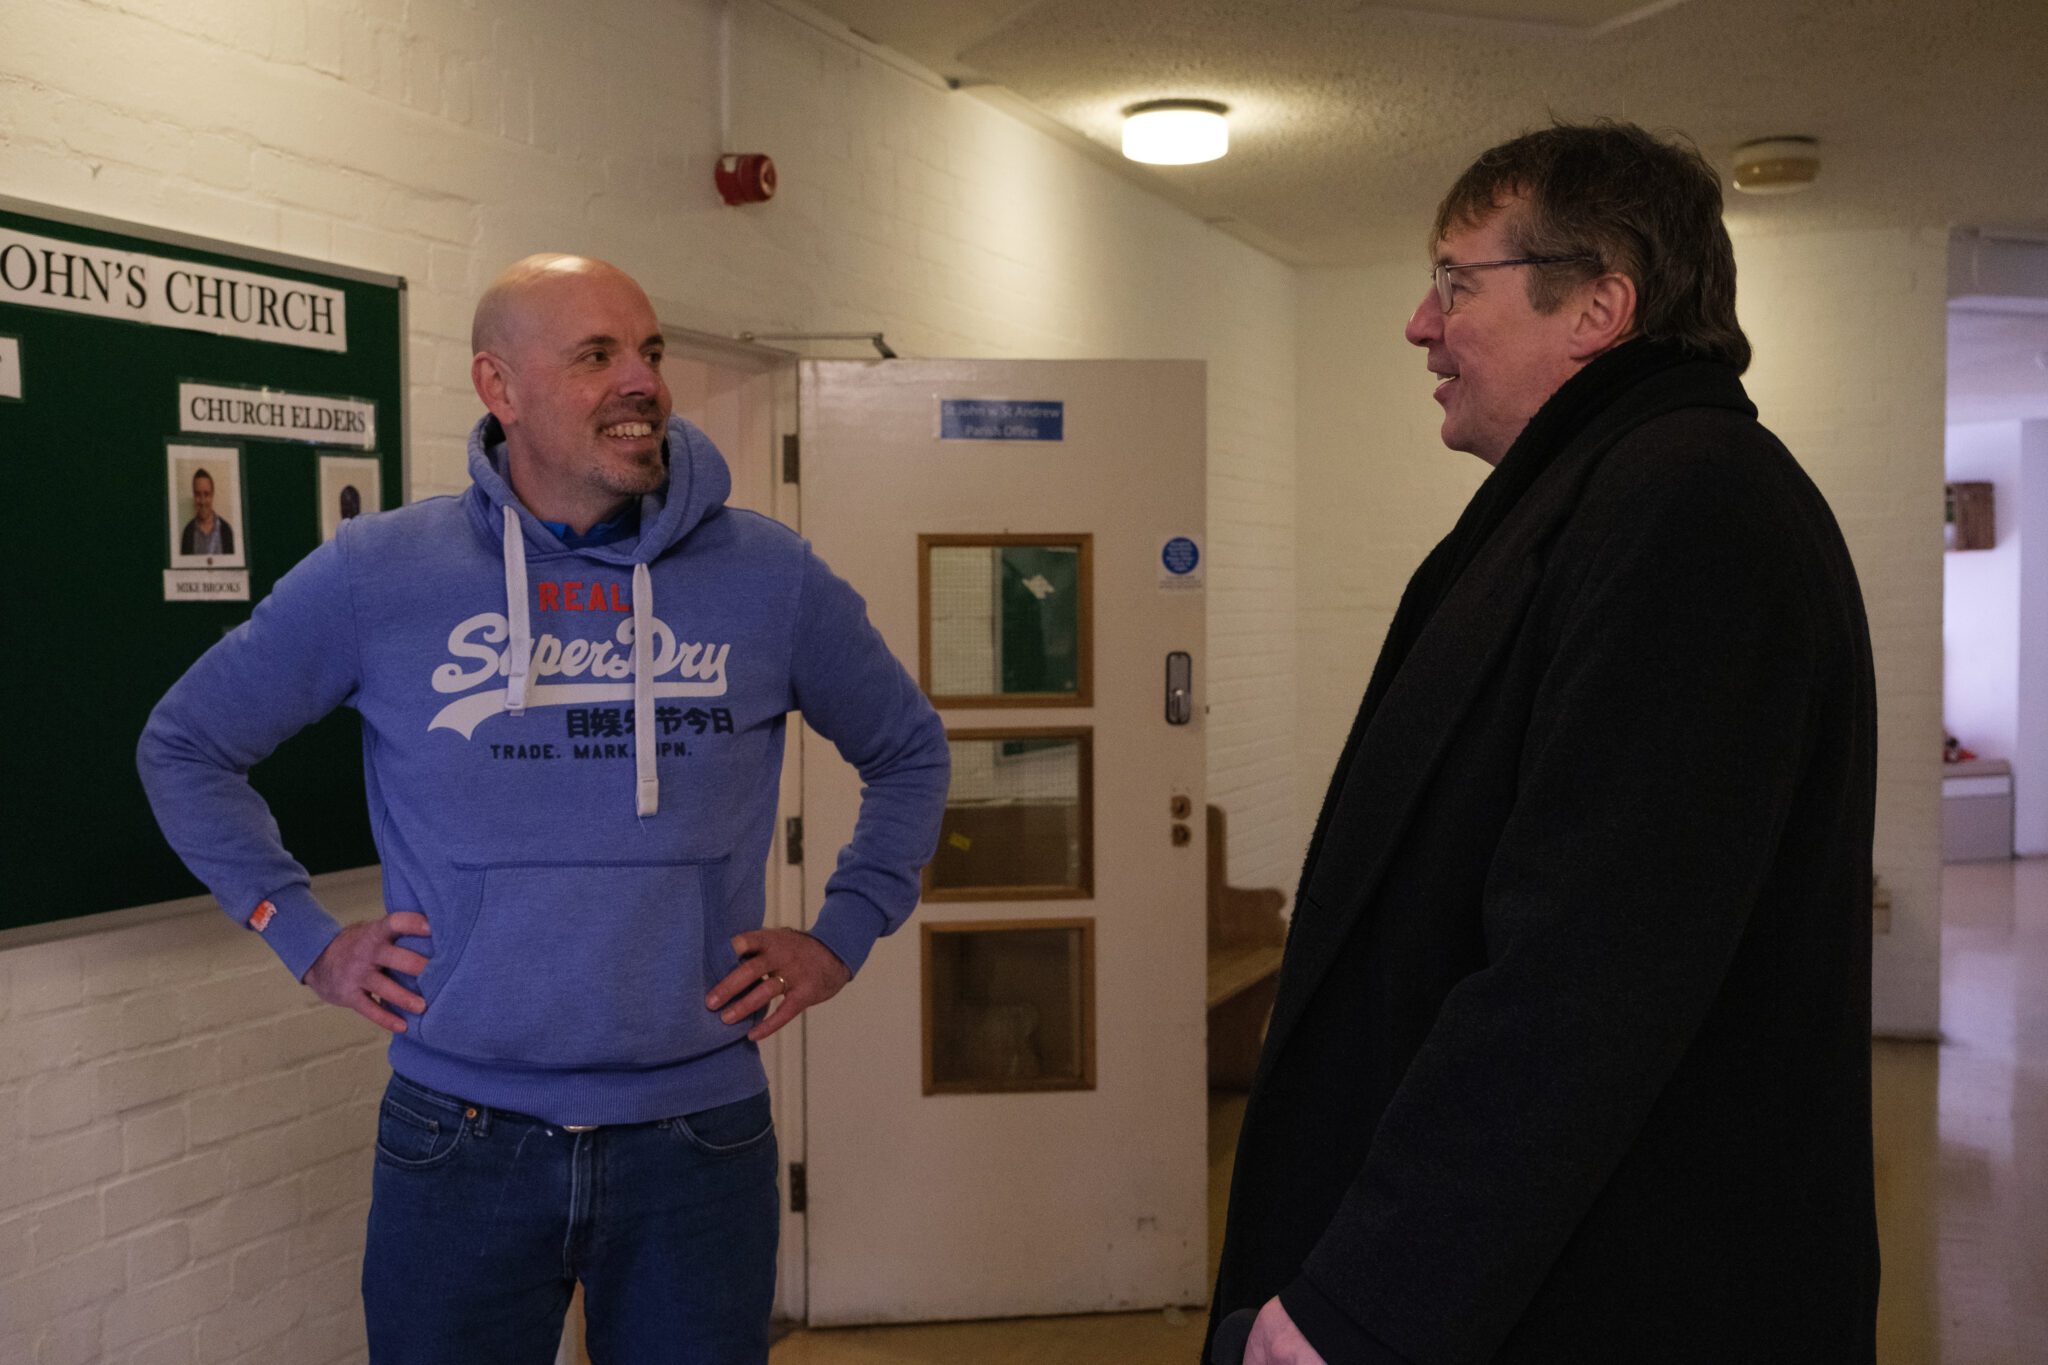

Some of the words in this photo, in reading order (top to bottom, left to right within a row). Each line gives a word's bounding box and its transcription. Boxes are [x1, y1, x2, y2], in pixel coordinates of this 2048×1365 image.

[0, 243, 147, 309] OHN'S
[165, 270, 336, 336] CHURCH
[190, 396, 285, 427] CHURCH
[291, 405, 366, 433] ELDERS
[176, 582, 199, 593] MIKE
[202, 582, 241, 593] BROOKS
[490, 745, 561, 760] TRADE.
